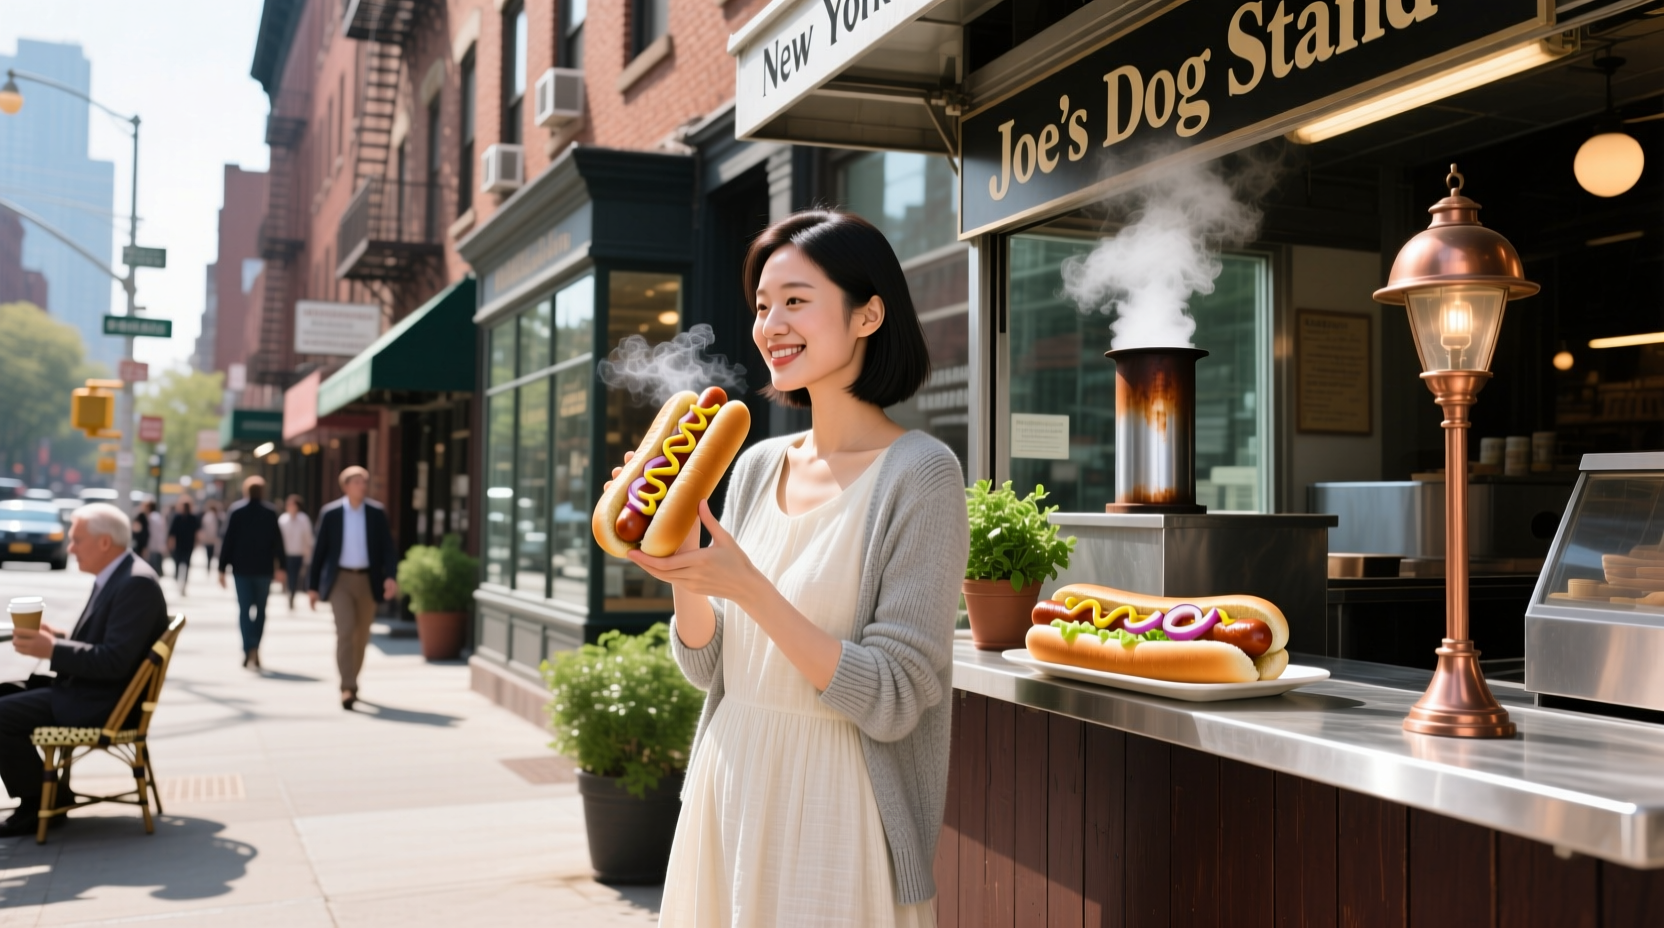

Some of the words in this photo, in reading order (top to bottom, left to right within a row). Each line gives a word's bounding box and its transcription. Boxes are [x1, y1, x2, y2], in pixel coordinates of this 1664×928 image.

[763, 25, 814, 97] New
[823, 0, 891, 46] Yo
[989, 95, 1088, 201] Joe's
[1103, 48, 1211, 147] Dog
